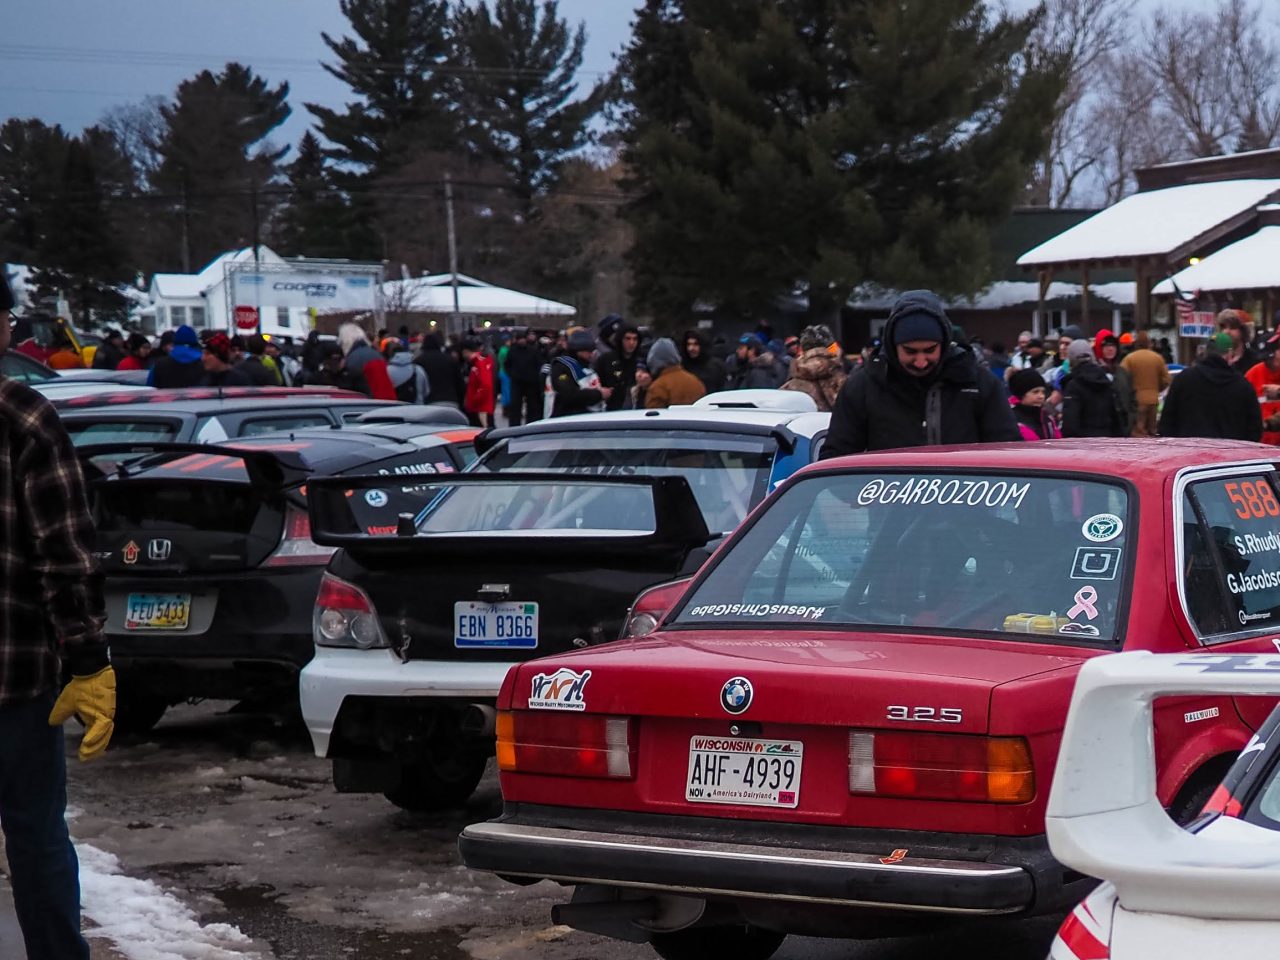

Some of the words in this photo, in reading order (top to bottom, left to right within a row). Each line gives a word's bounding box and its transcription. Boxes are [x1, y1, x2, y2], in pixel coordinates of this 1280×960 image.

[273, 281, 338, 291] COOPER
[857, 477, 1031, 509] @GARBOZOOM
[1224, 480, 1280, 520] 588
[156, 602, 185, 620] 5433
[691, 603, 826, 619] #JesusChristGabe
[459, 615, 487, 638] EBN
[496, 615, 533, 638] 8366
[886, 705, 962, 724] 325
[694, 739, 753, 752] WISCONSIN
[691, 753, 795, 790] AHF-4939
[689, 788, 704, 798] NOV
